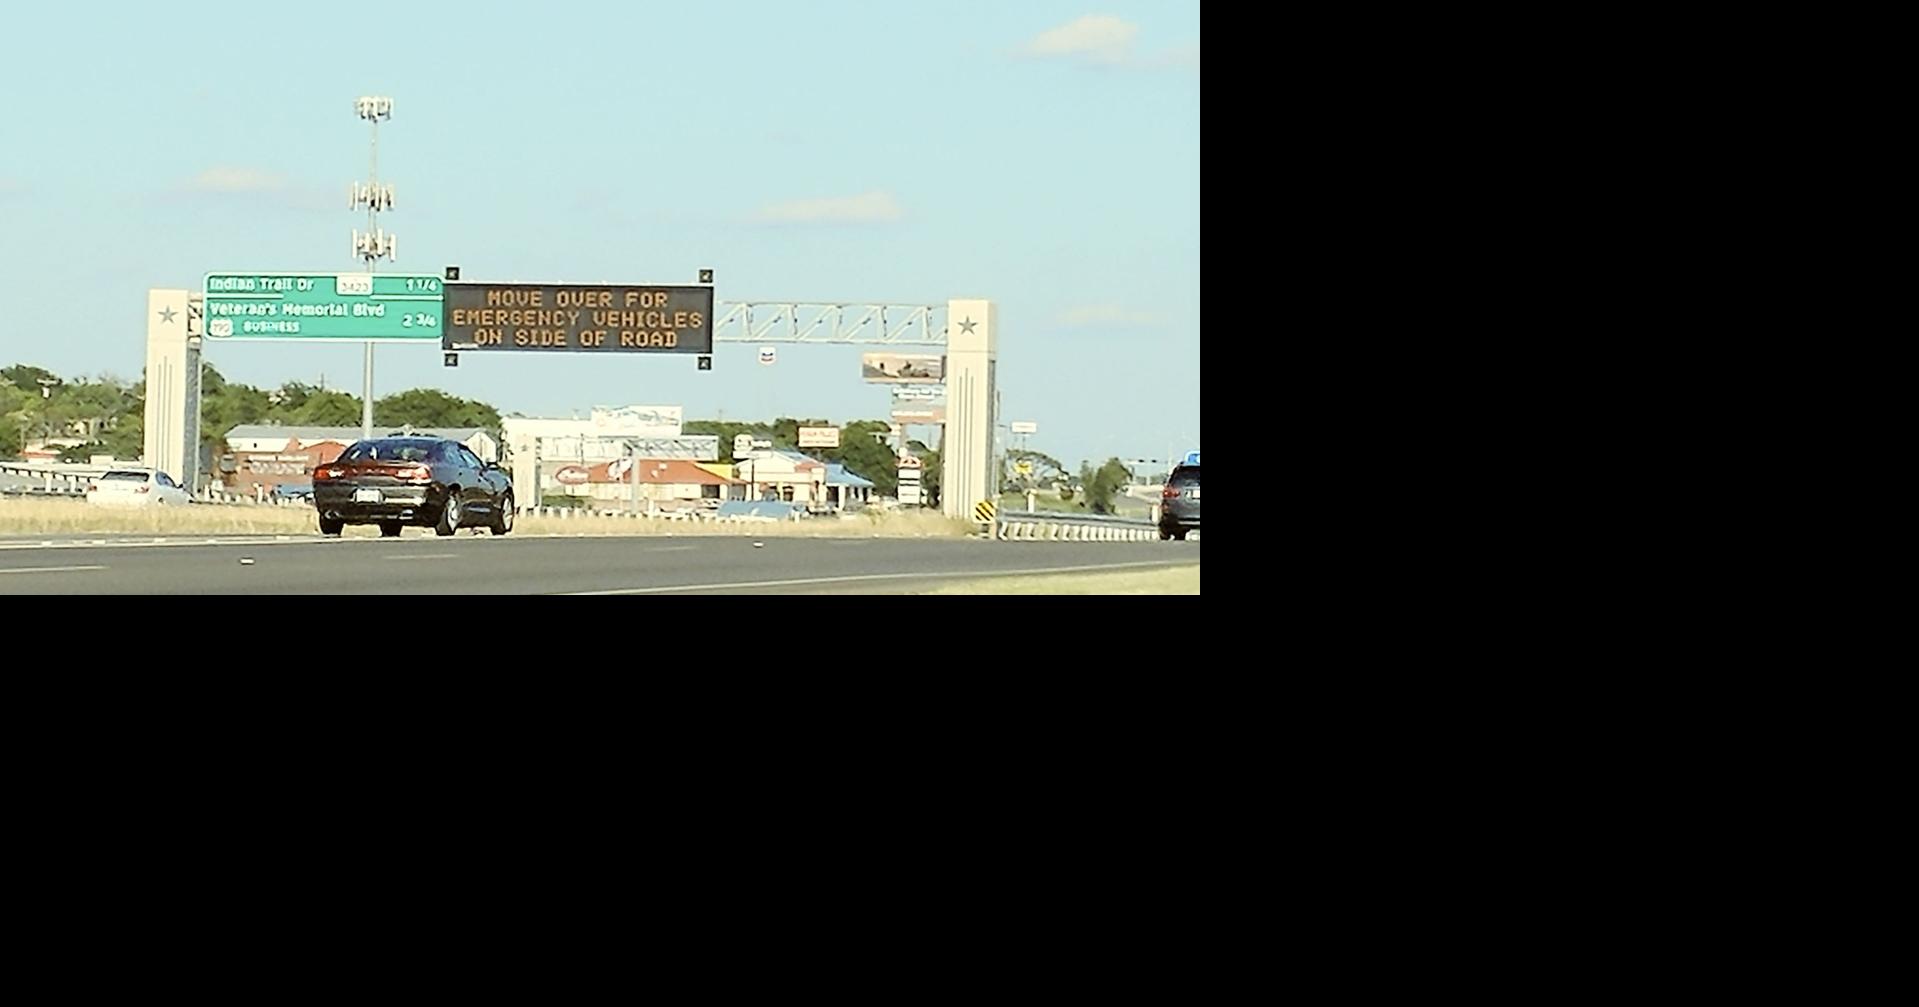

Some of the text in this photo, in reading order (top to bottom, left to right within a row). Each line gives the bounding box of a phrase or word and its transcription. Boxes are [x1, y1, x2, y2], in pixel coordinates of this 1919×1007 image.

[209, 277, 314, 291] Indian Trail Dr
[487, 290, 669, 308] MOVE OVER FOR
[209, 302, 385, 317] Veteran's Memorial Blvd
[243, 320, 300, 333] BUSINESS
[452, 309, 703, 328] EMERGENCY VEHICLES
[474, 328, 679, 348] ON SIDE OF ROAD
